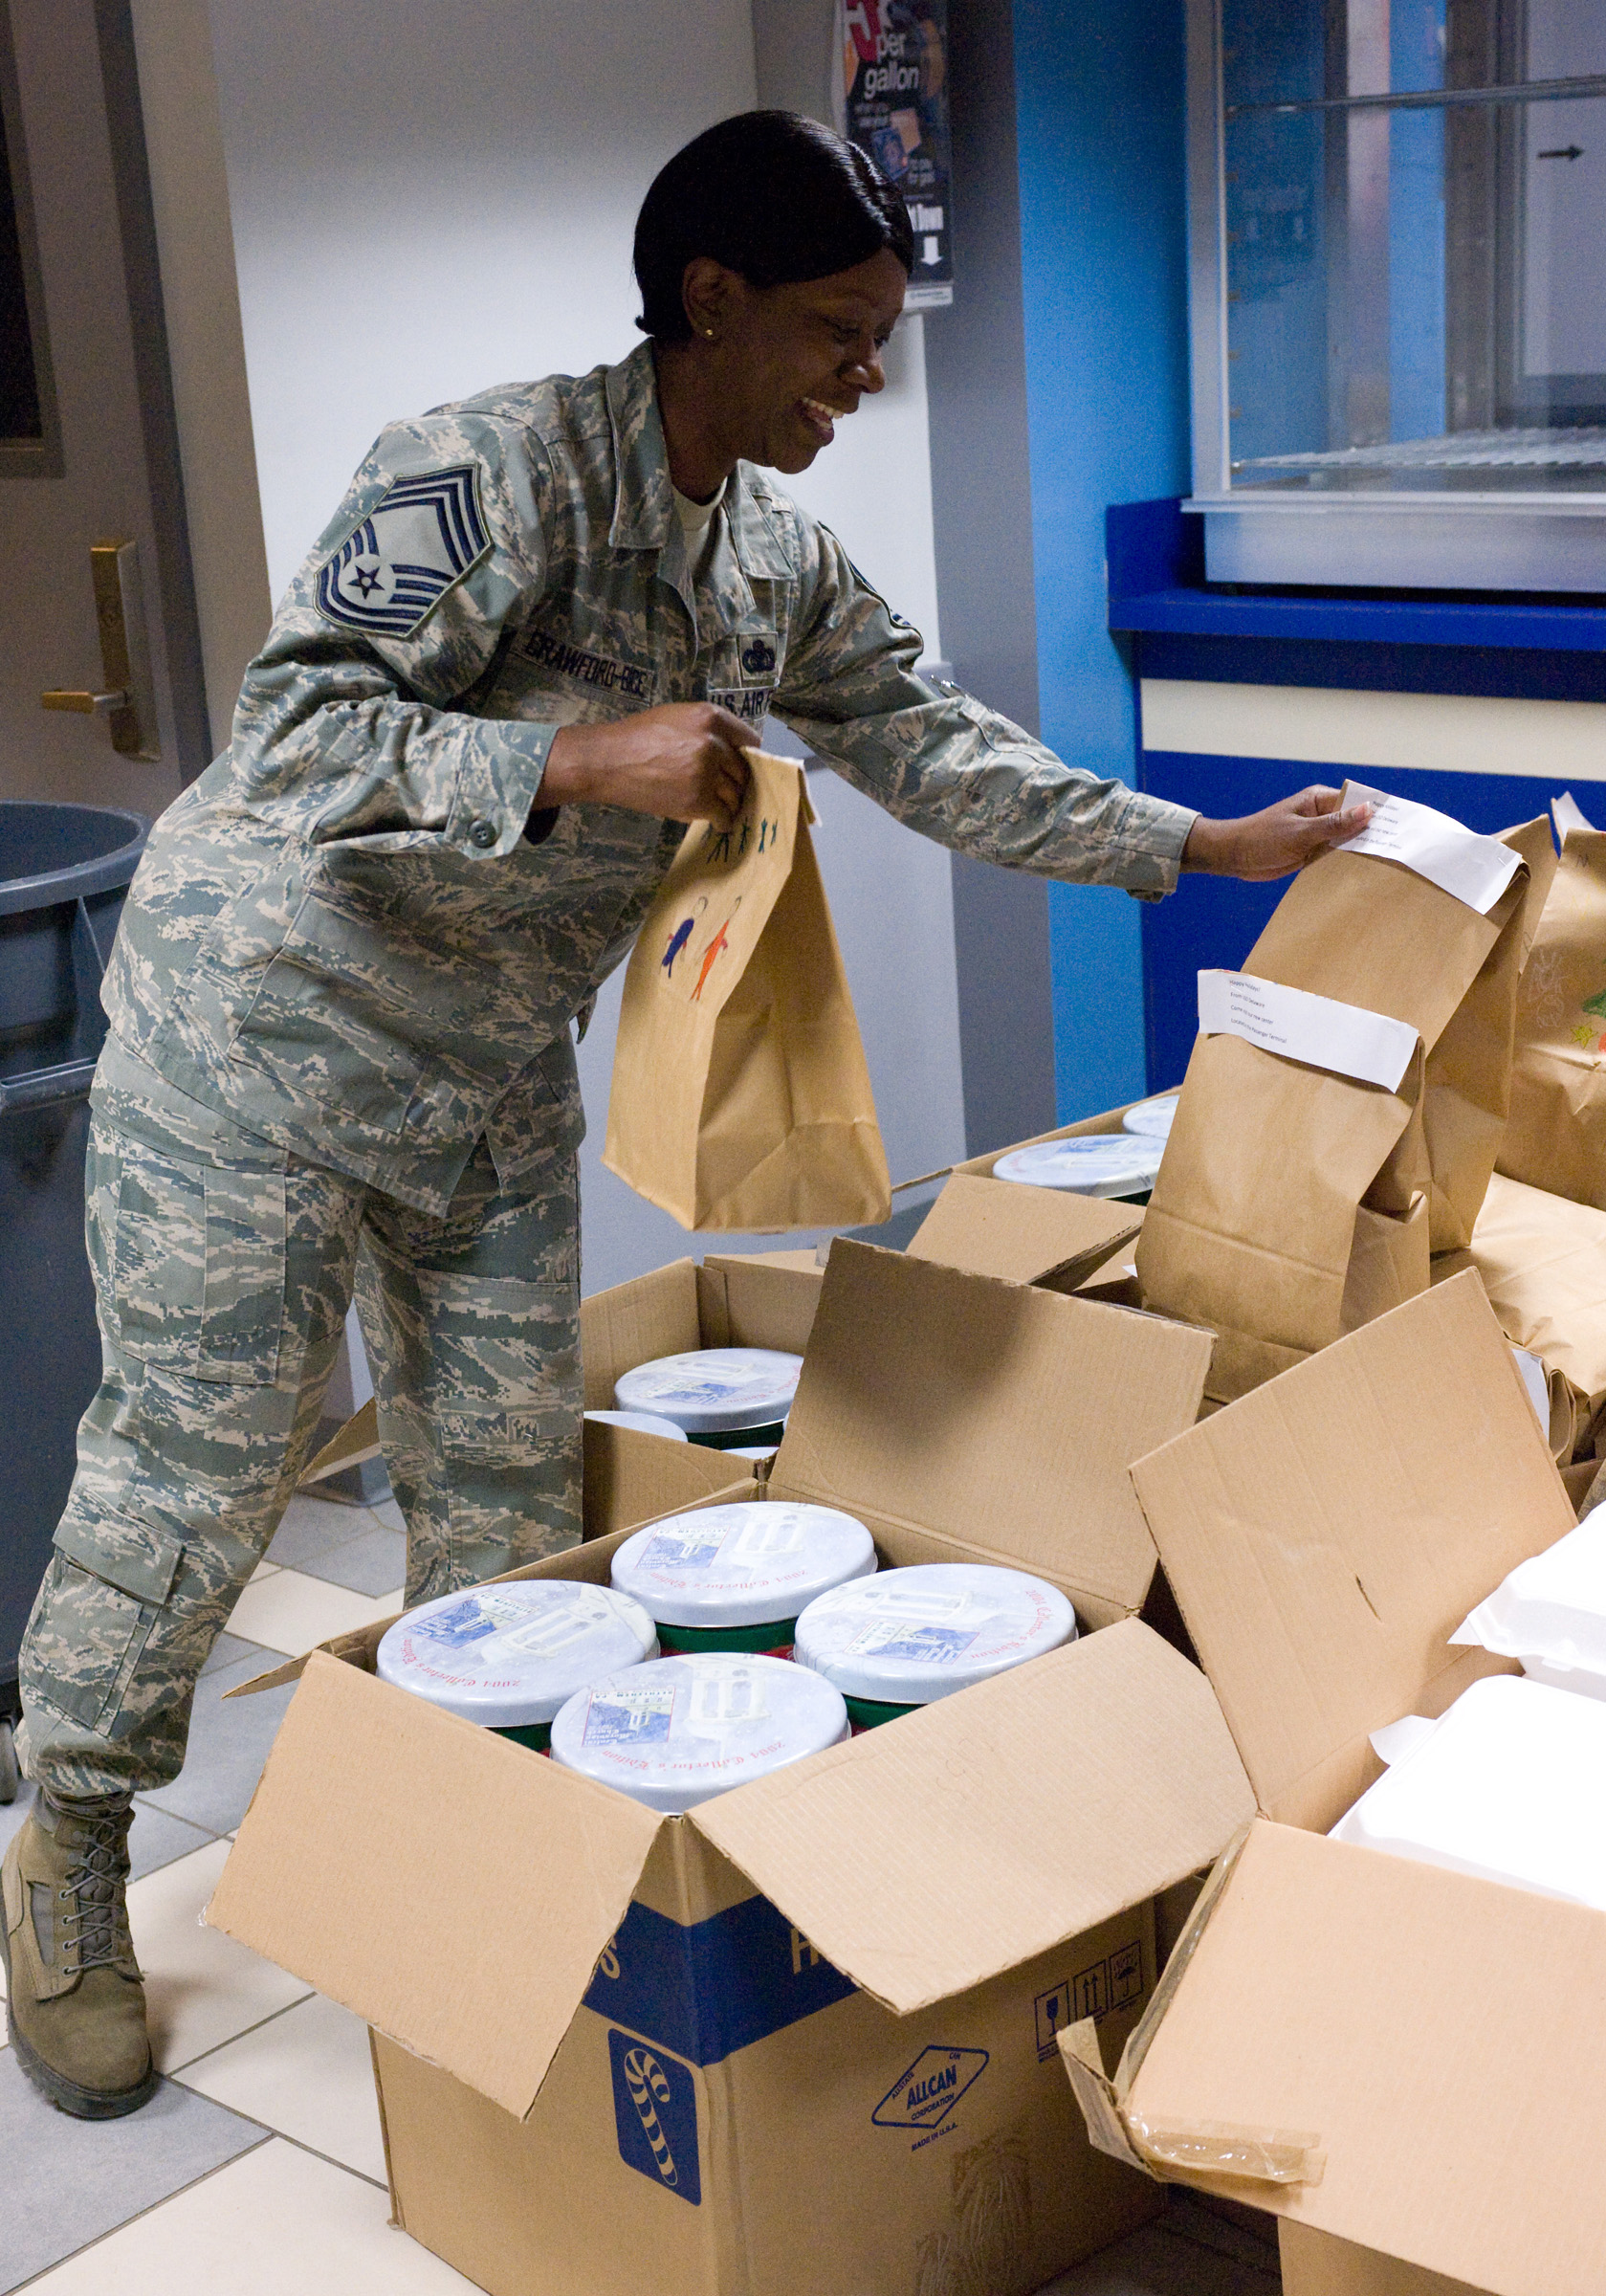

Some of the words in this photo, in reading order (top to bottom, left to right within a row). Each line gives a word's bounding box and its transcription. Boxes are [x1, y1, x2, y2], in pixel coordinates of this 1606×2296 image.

[864, 61, 919, 99] gallon
[739, 691, 764, 718] AIR
[907, 2064, 957, 2110] ALLCAN
[911, 2092, 955, 2121] CORPORATION
[912, 2136, 930, 2152] MADE
[931, 2131, 938, 2140] IN
